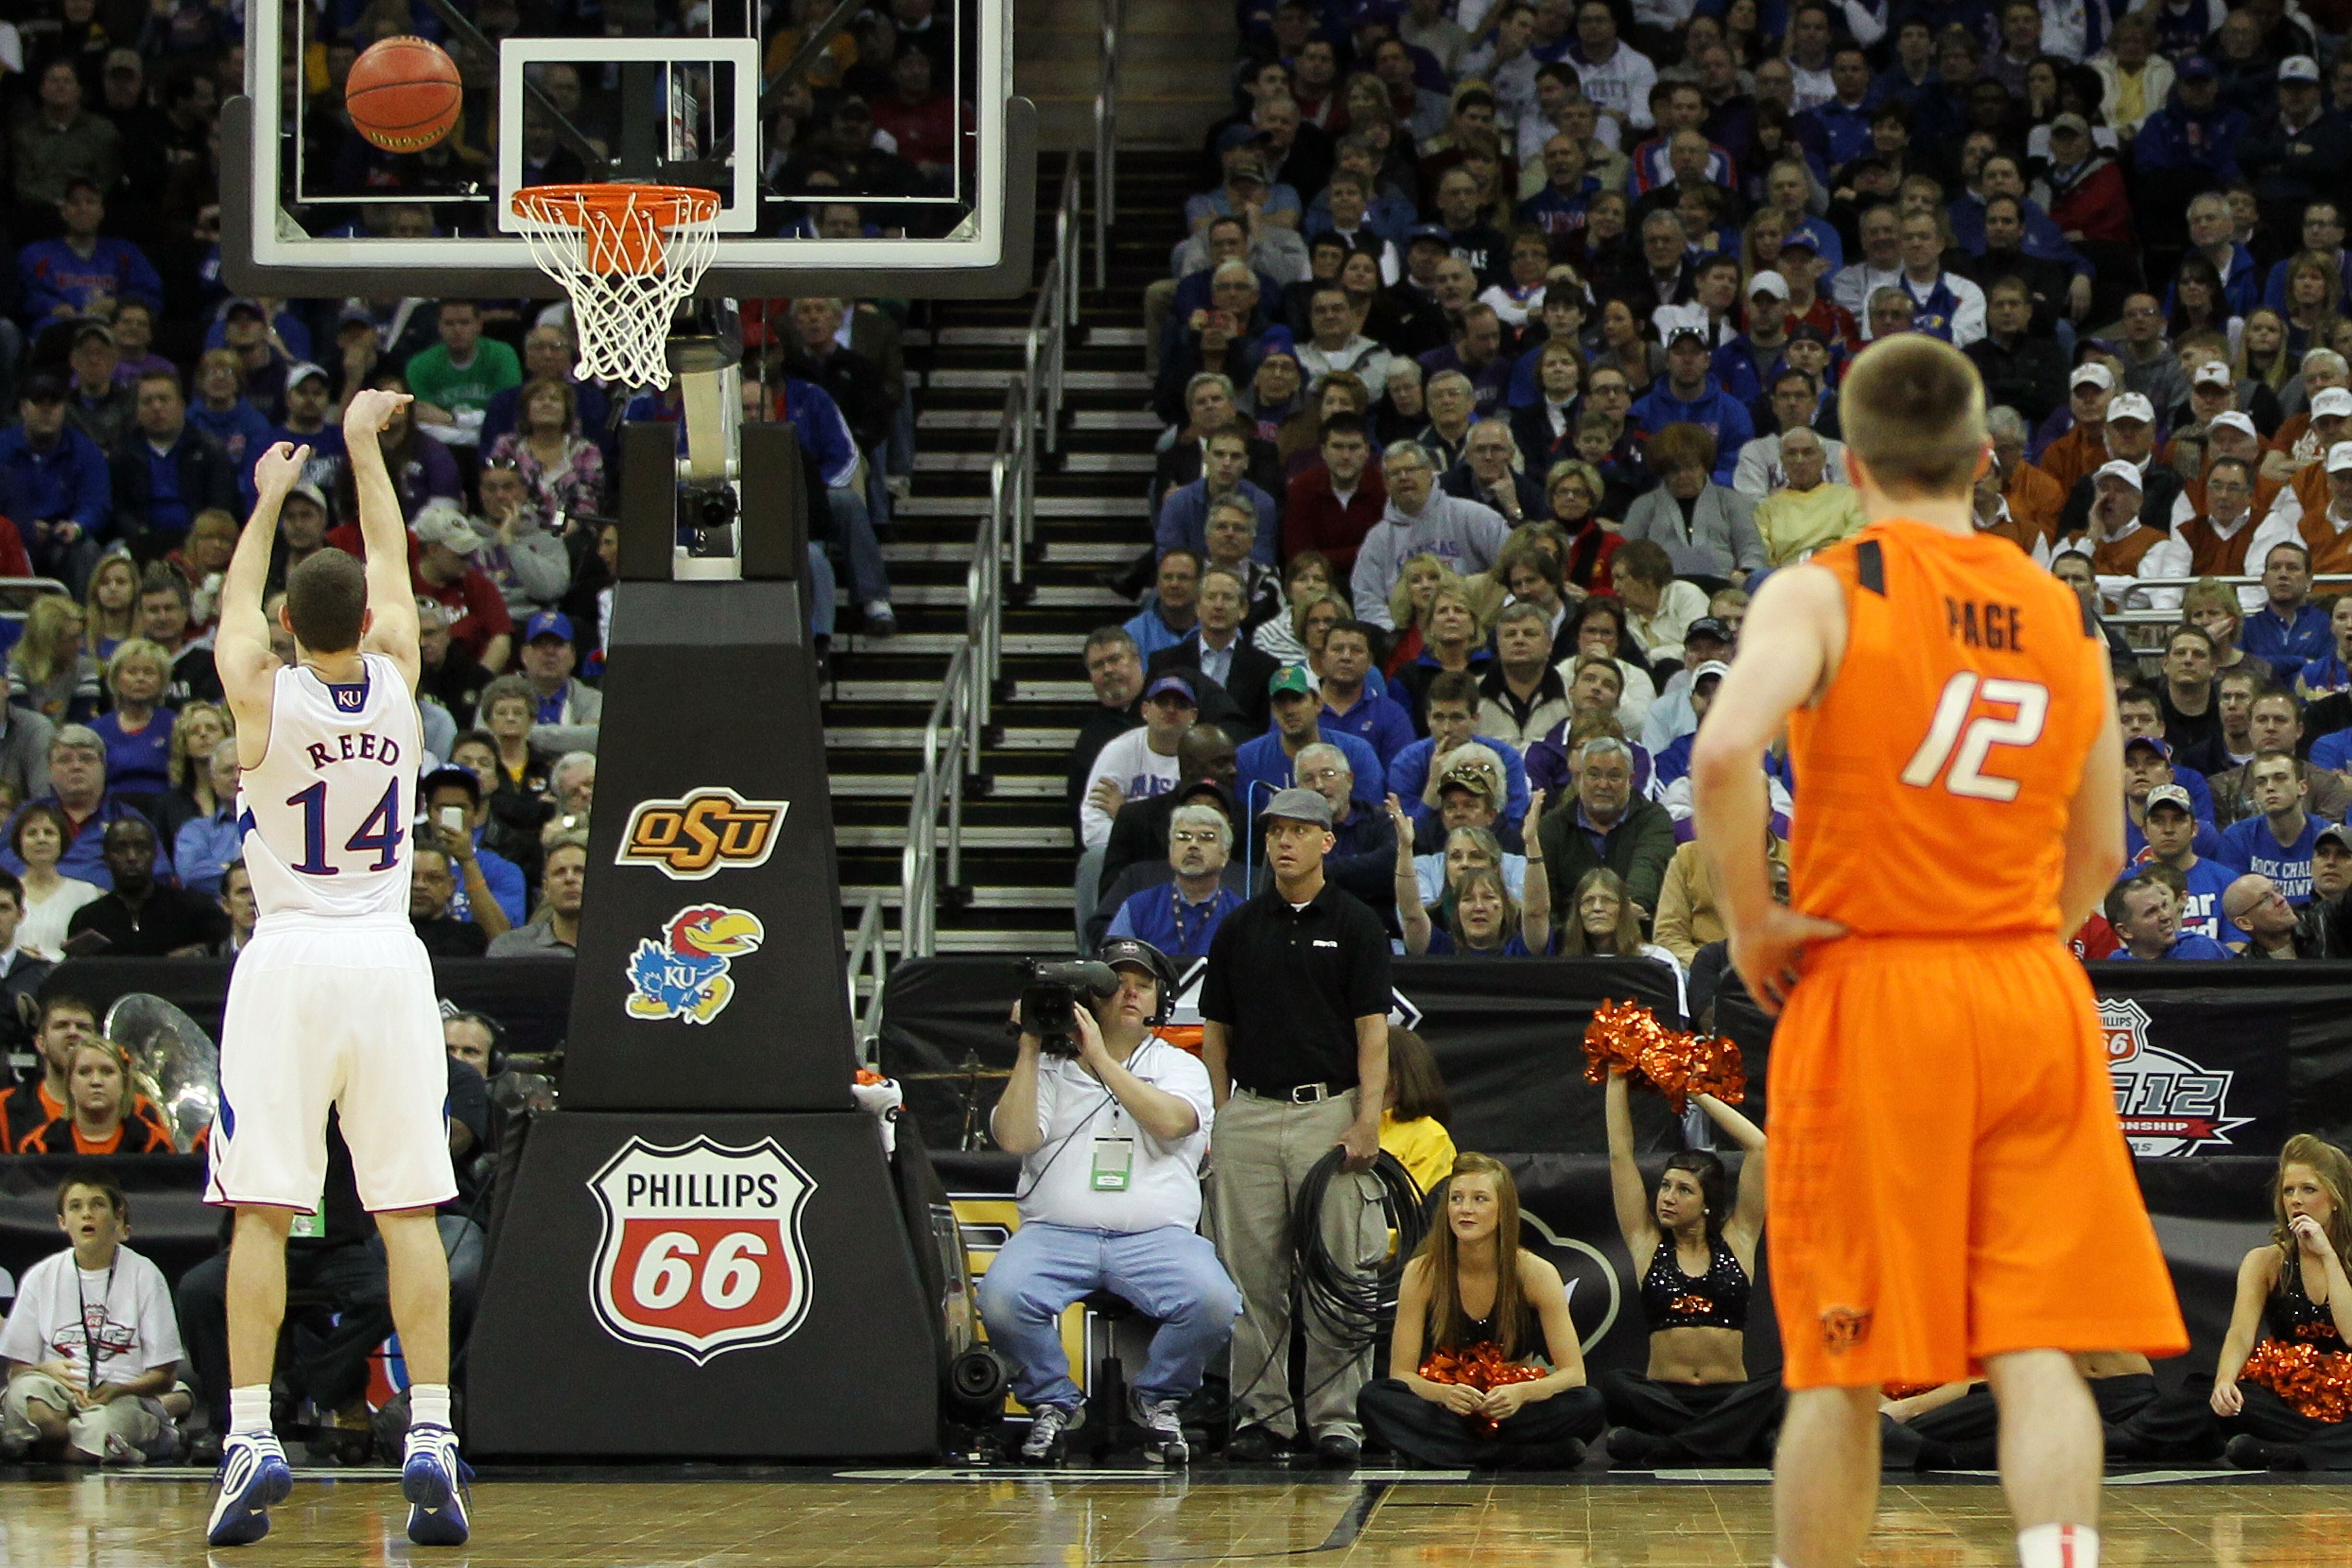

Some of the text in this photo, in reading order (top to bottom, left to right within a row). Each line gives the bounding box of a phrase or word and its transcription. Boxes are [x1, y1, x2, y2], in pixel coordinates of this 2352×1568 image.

[338, 691, 361, 708] KU
[306, 733, 400, 770] REED
[1900, 670, 2049, 803] 12
[286, 775, 405, 875] 14
[626, 795, 776, 872] OSU
[2282, 861, 2312, 879] CHAL
[2182, 893, 2216, 919] ar
[664, 966, 698, 990] KU
[2098, 1017, 2132, 1027] ILLIPS
[2119, 1122, 2189, 1131] ONSHIP
[627, 1174, 778, 1208] PHILLIPS
[632, 1231, 769, 1310] 66
